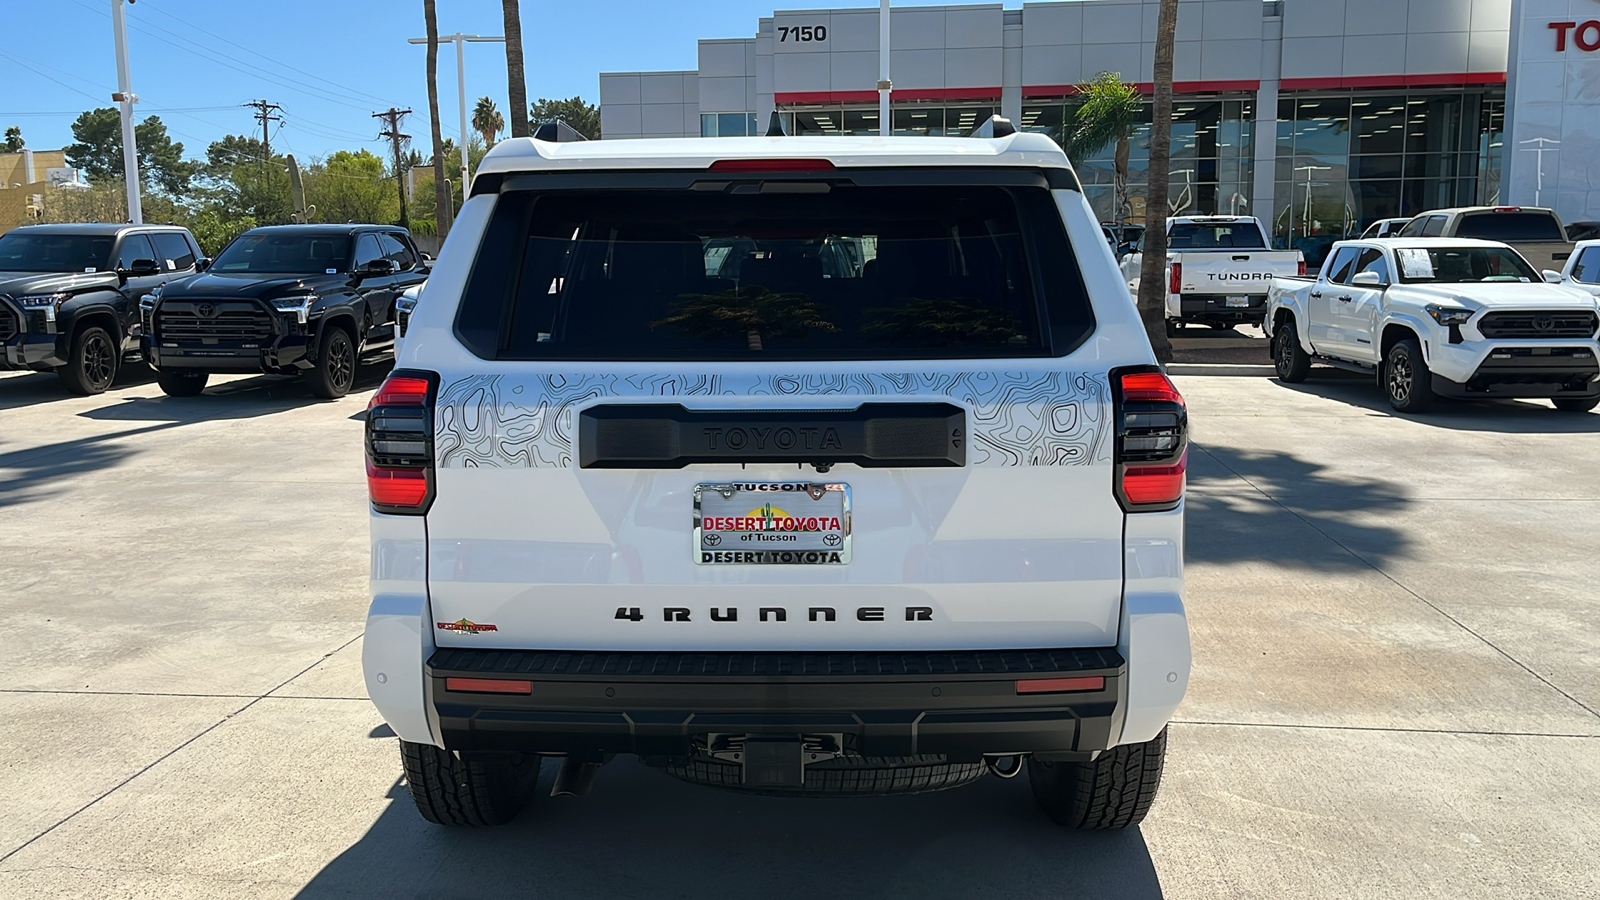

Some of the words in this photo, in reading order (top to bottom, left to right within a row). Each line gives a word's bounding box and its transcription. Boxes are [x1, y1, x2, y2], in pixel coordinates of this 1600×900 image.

[778, 26, 827, 42] 7150
[1547, 20, 1600, 52] TO
[1207, 273, 1273, 281] TUNDRA
[703, 427, 842, 450] TOYOTA
[734, 483, 808, 492] TUCSON
[703, 517, 767, 531] DESERT
[773, 517, 841, 531] TOYOTA
[741, 533, 754, 542] of
[754, 533, 797, 542] Tucson
[702, 552, 764, 563] DESERT
[770, 552, 842, 563] TOYOTA
[614, 606, 933, 622] 4RUNNER
